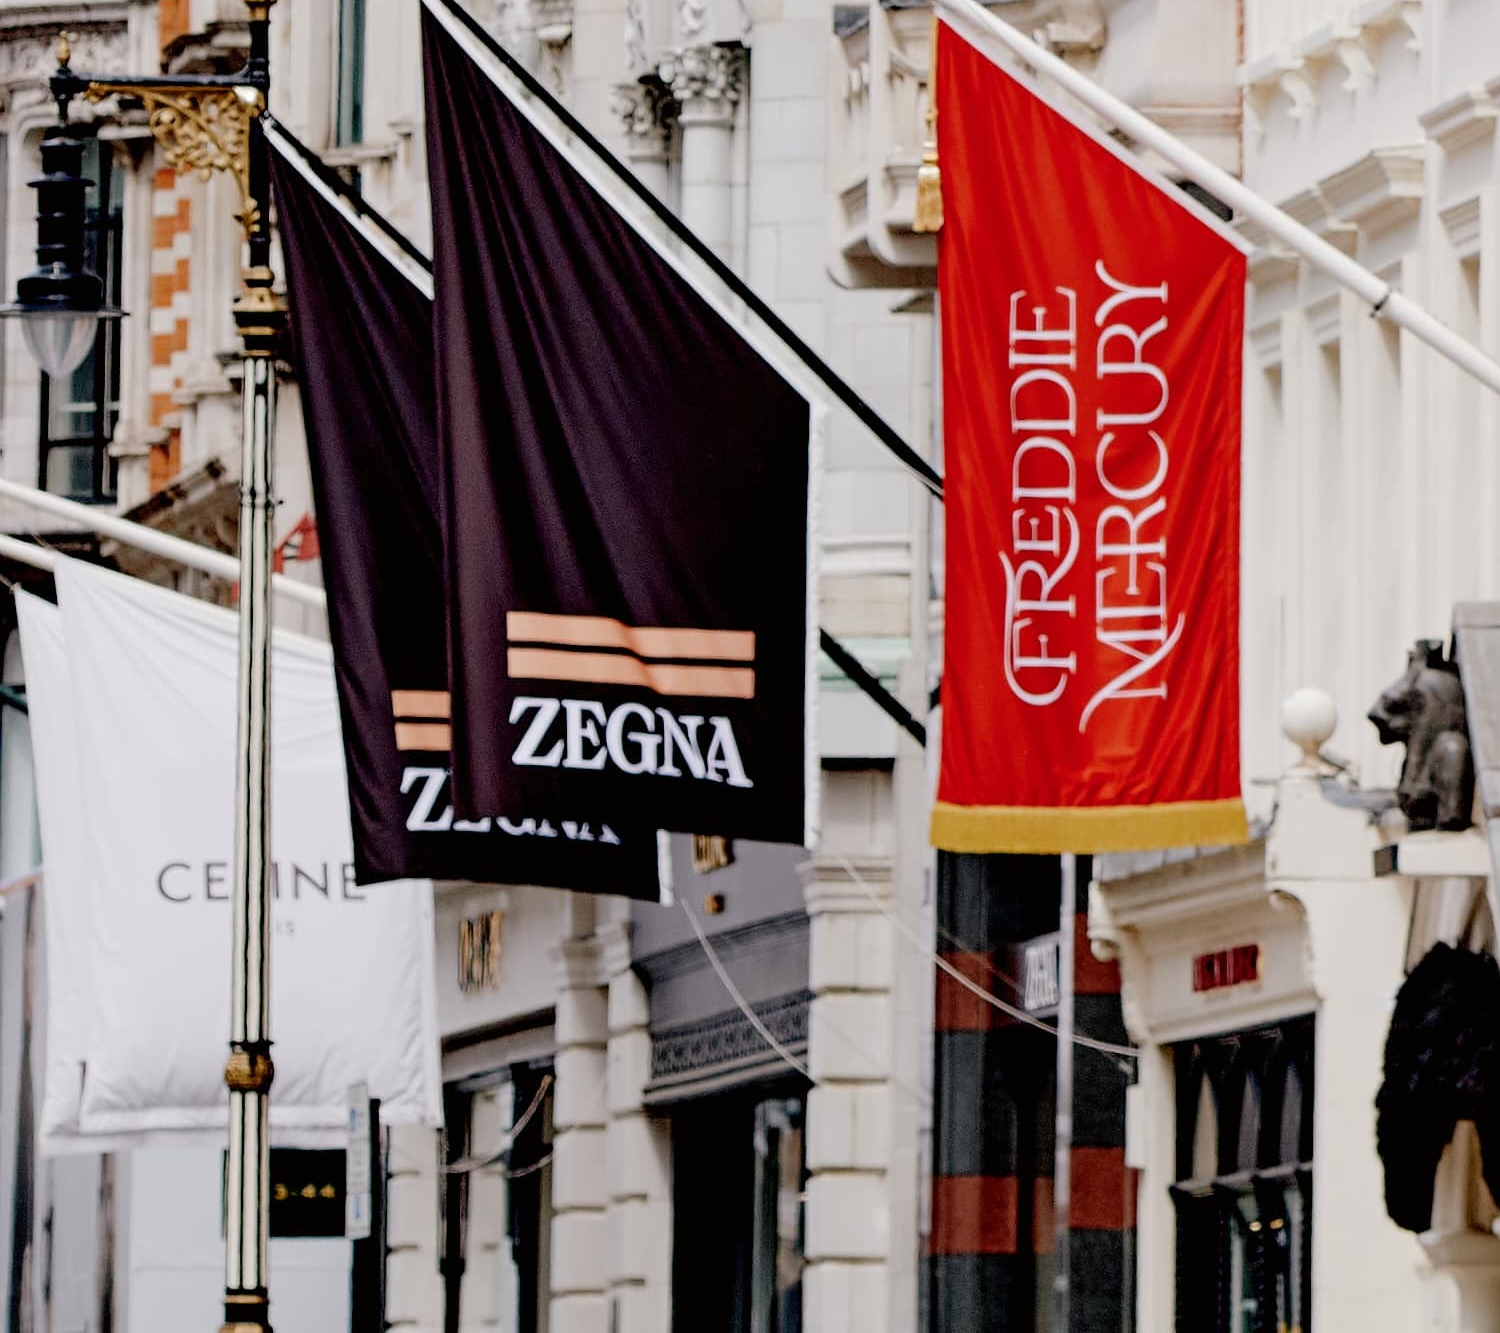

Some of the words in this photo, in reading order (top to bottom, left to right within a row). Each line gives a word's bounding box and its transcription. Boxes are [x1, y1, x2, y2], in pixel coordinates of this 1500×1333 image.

[999, 286, 1080, 706] FREDDIE
[1079, 259, 1185, 733] MERCURY
[509, 697, 754, 788] ZEGNA
[157, 861, 366, 902] CEINE
